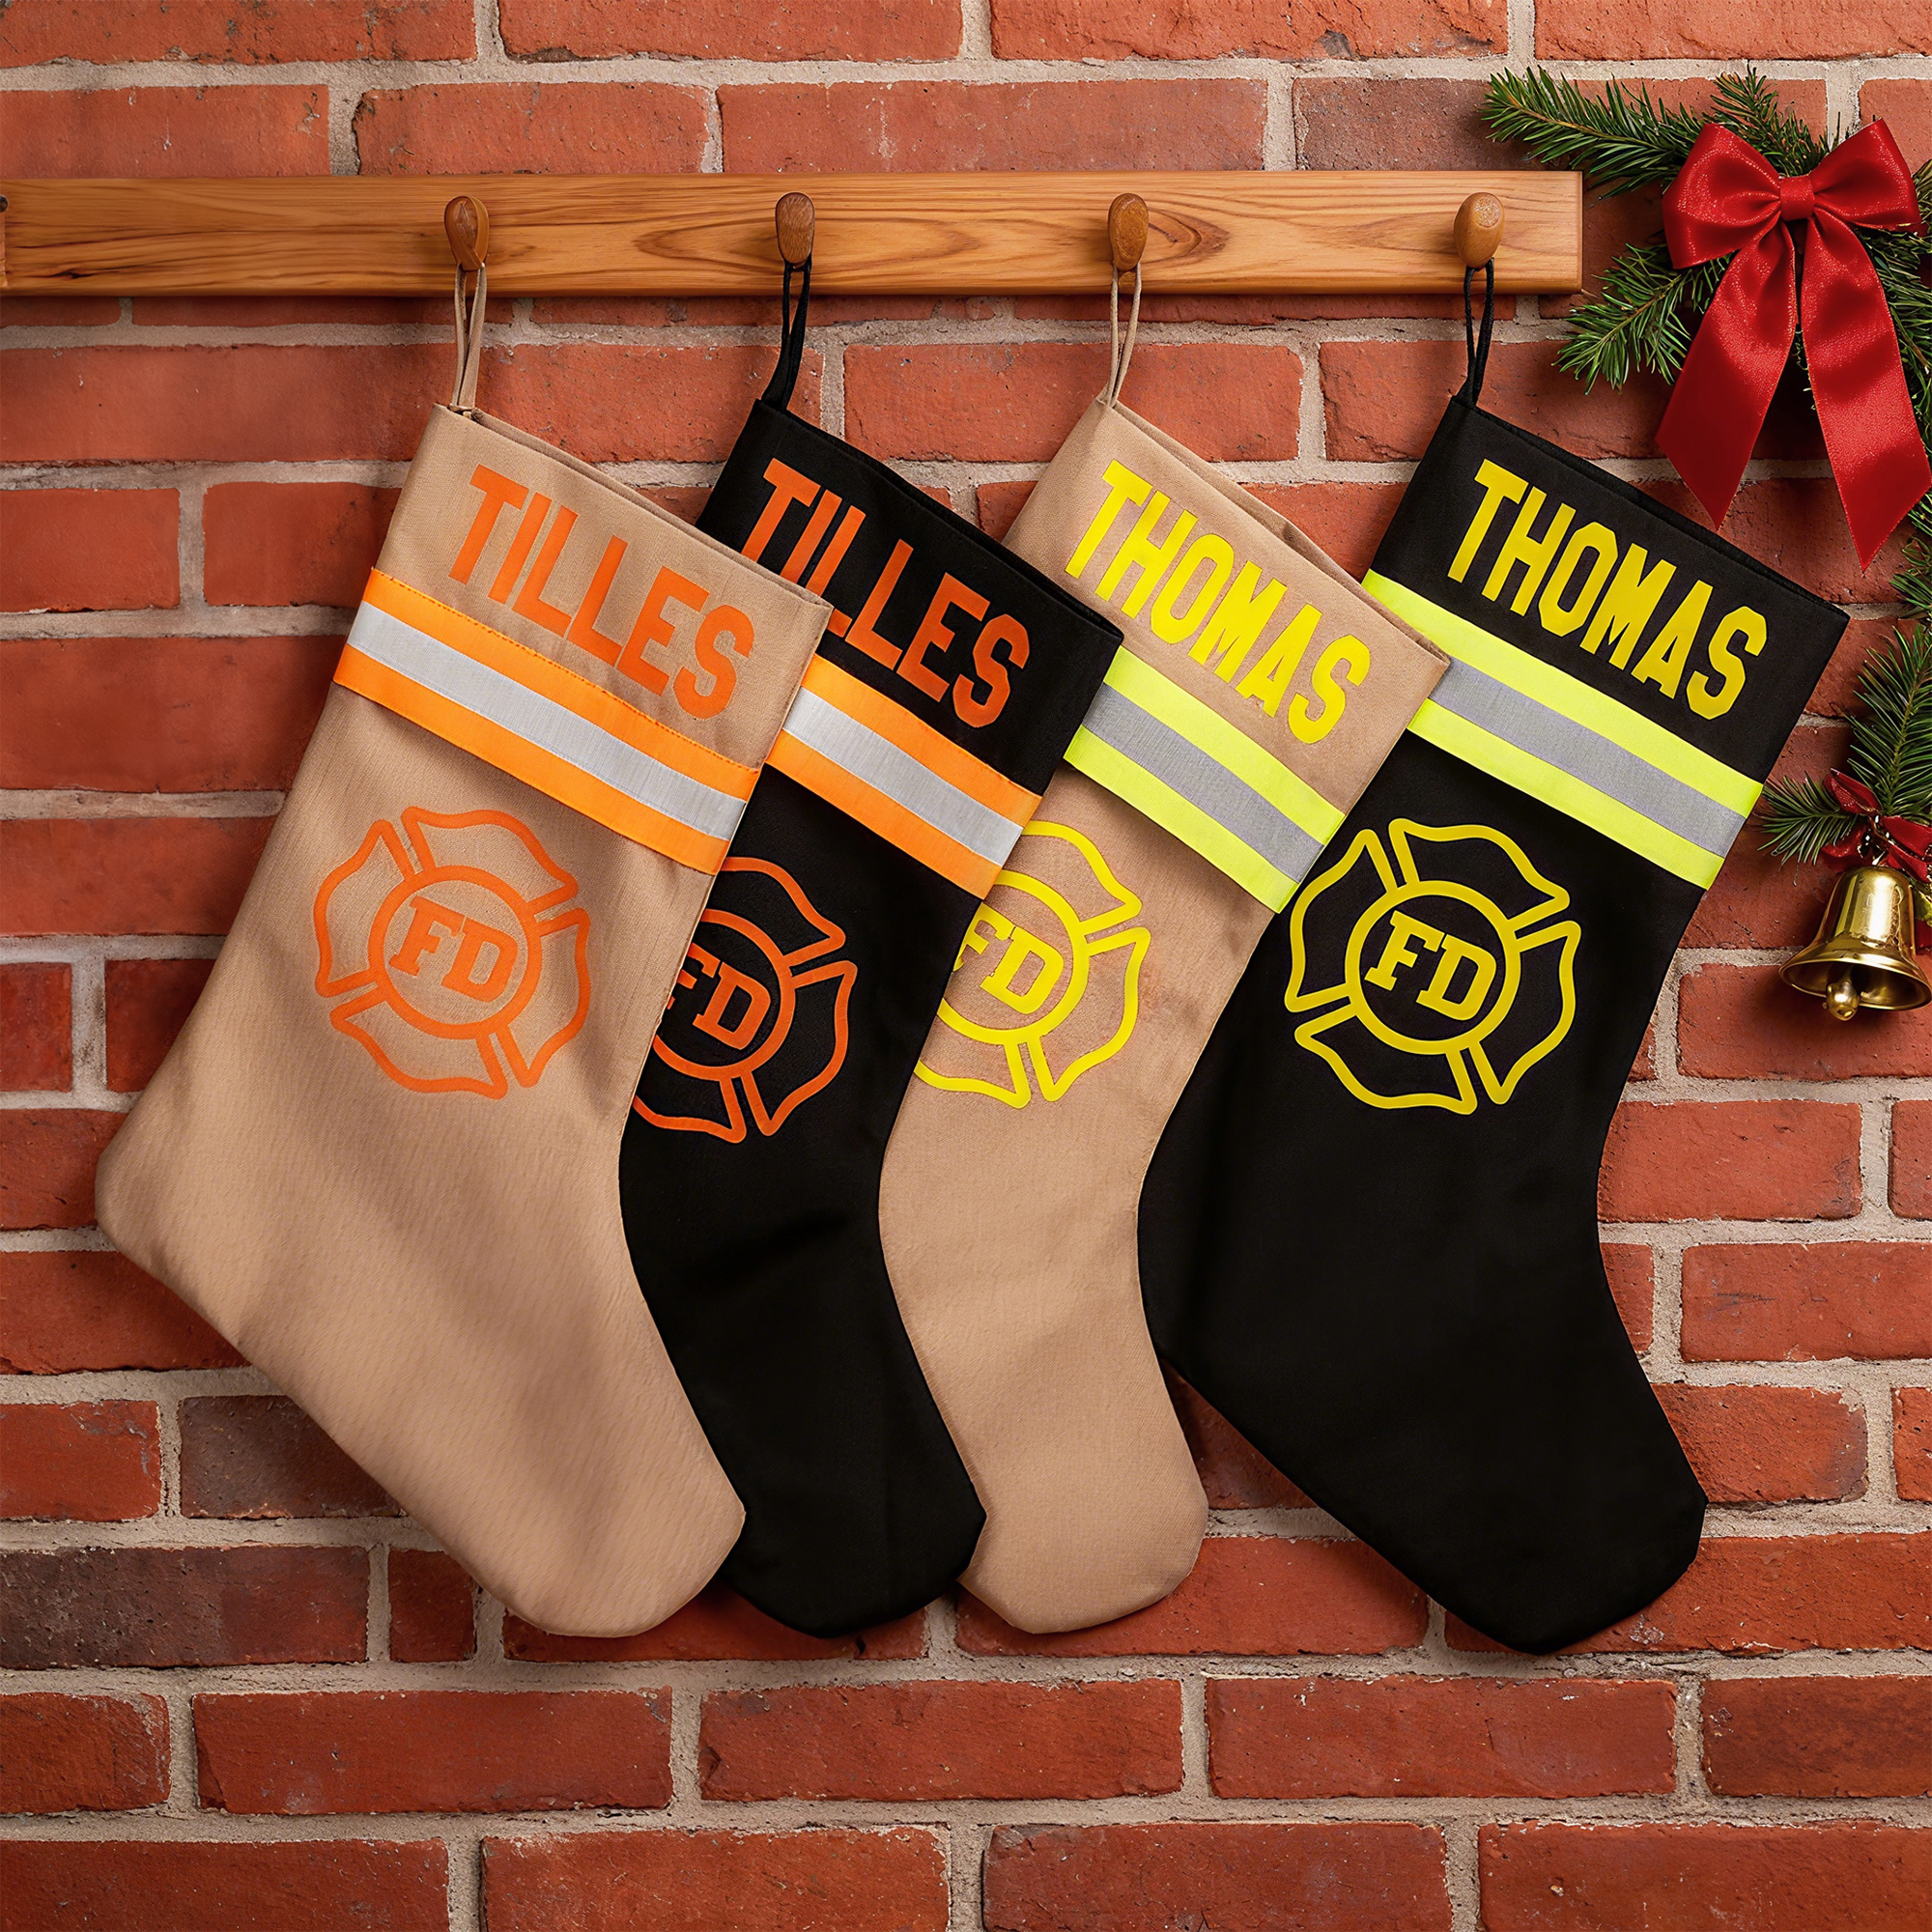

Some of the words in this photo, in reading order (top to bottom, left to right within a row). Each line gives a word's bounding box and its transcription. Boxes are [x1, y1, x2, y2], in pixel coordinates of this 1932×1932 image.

[448, 465, 753, 719] TILLES
[742, 458, 1030, 727] TILLES
[1065, 460, 1371, 744] THOMAS
[1449, 460, 1767, 720] THOMAS
[388, 895, 518, 1003] FD
[1365, 910, 1496, 1021] FD
